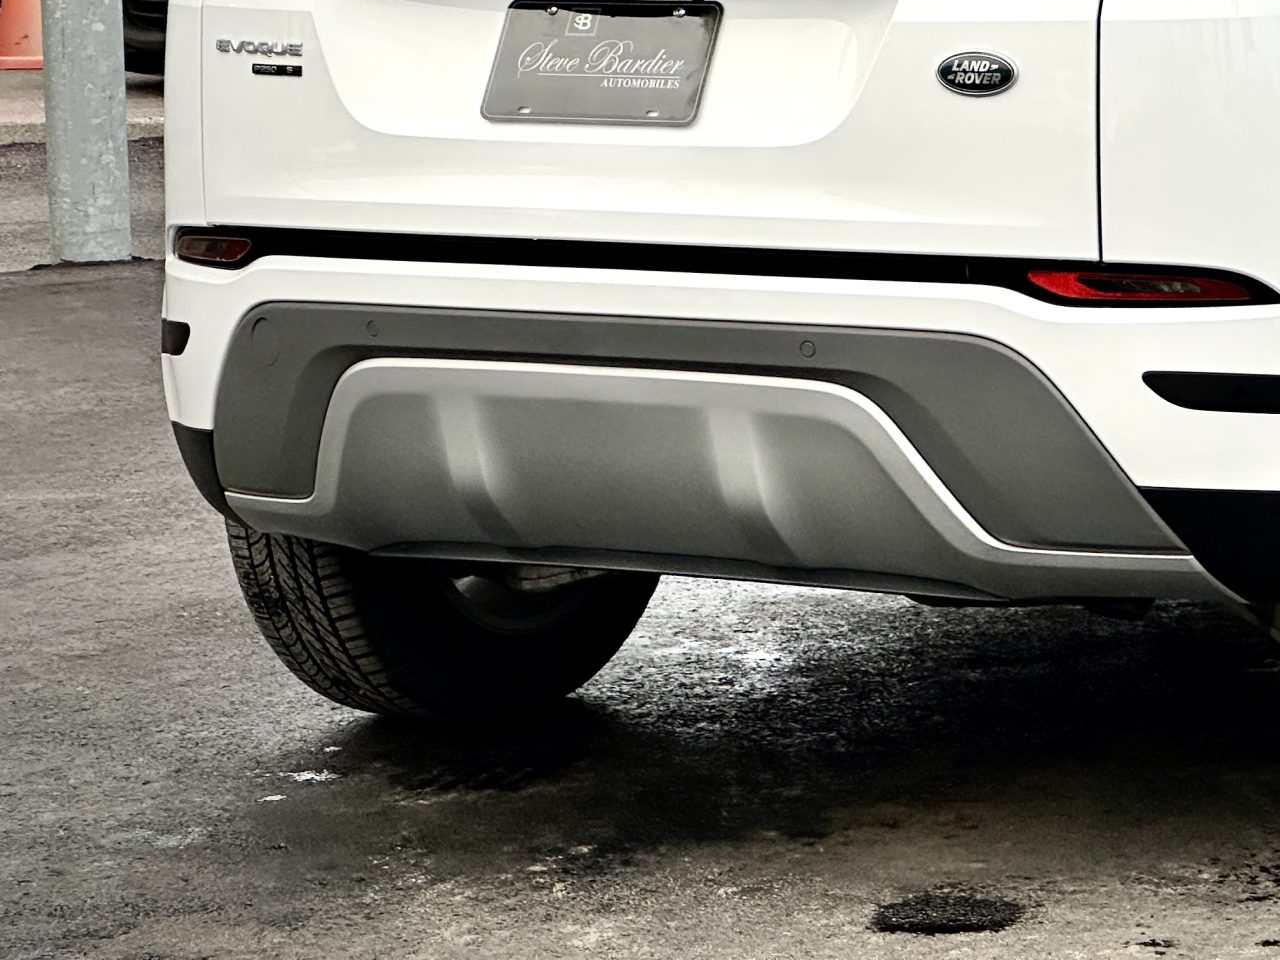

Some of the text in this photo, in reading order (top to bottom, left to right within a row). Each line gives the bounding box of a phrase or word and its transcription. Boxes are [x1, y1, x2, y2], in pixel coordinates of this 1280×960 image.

[215, 39, 303, 57] EVOQUE
[517, 39, 685, 78] Steve Bardier
[951, 60, 990, 72] LAND
[600, 78, 681, 89] AUTOMOBILES
[955, 73, 1002, 84] ROVER
